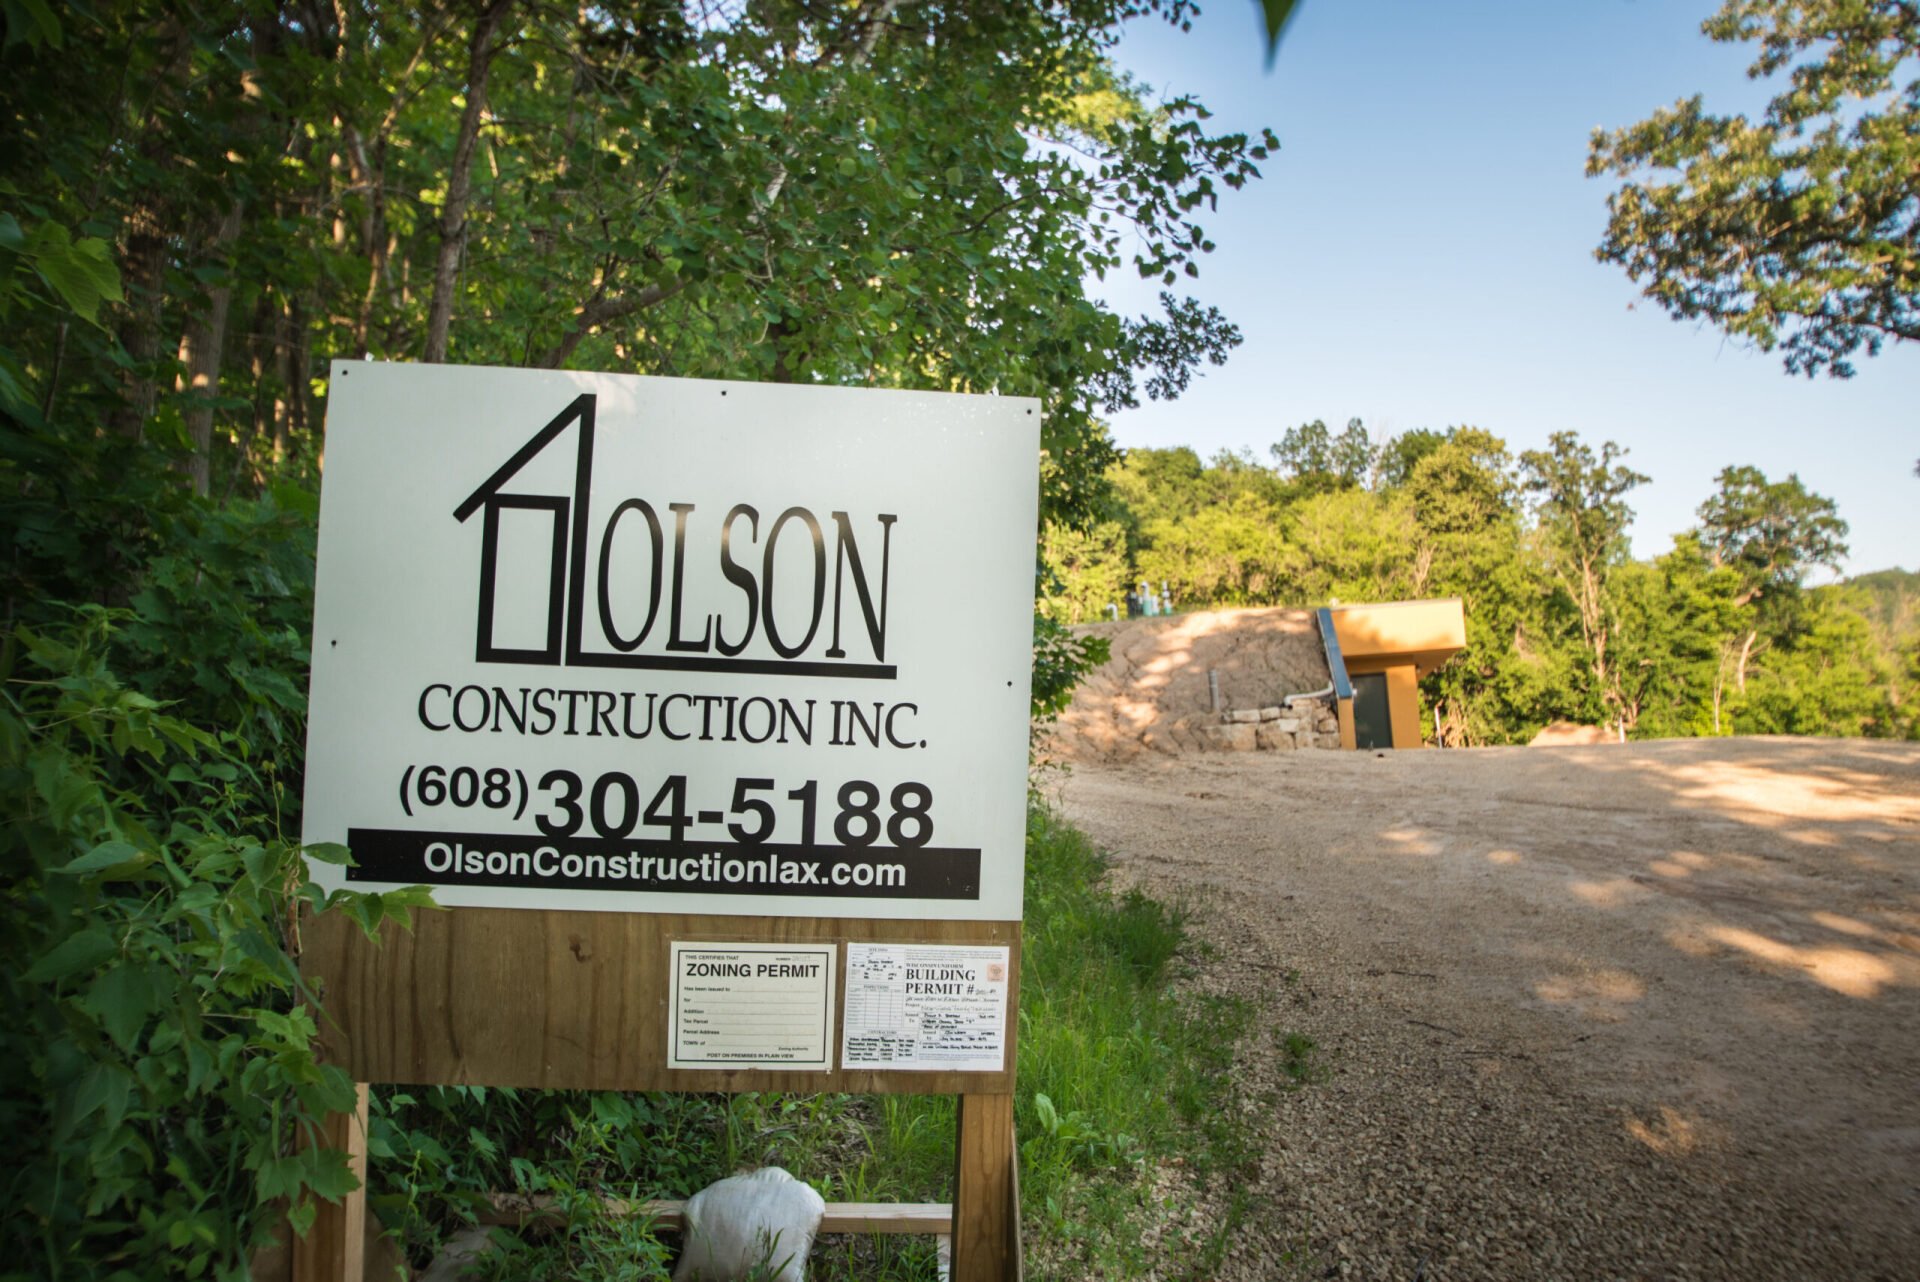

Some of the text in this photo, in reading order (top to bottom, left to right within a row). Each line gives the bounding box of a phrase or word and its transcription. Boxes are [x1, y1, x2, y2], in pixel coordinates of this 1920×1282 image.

[597, 497, 898, 663] OLSON
[417, 683, 928, 749] CONSTRUCTION INC.
[423, 842, 907, 887] OlsonConstructionlax.com
[686, 964, 819, 978] ZONING PERMIT
[906, 969, 975, 981] BUILDING
[906, 983, 963, 994] PERMIT
[967, 984, 974, 994] #
